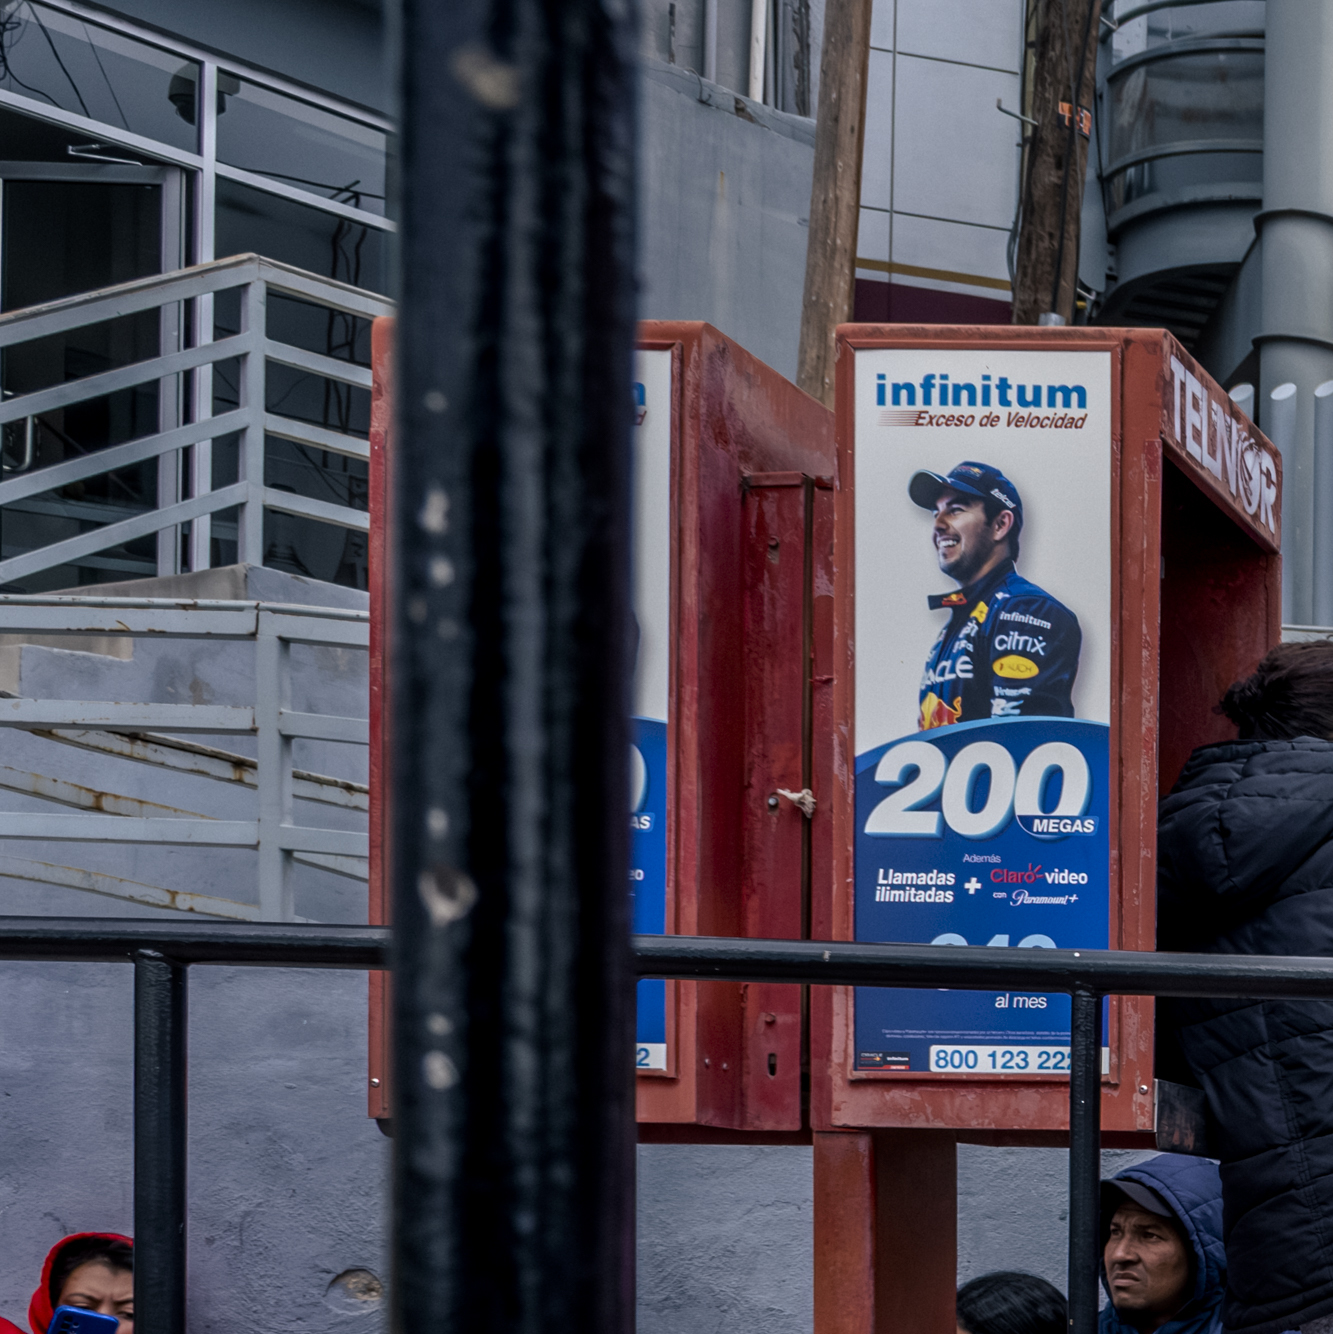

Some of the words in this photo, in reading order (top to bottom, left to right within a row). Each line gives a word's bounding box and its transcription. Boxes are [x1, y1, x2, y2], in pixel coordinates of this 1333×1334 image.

[876, 373, 1087, 409] infinitum
[914, 410, 975, 427] Exceso
[979, 411, 1000, 427] de
[1006, 411, 1088, 429] Velocidad
[1170, 354, 1277, 534] TELNOR
[1000, 611, 1051, 629] infinitum
[994, 631, 1046, 655] citrix
[864, 740, 1091, 840] 200
[1033, 819, 1094, 833] MEGAS
[963, 853, 1001, 863] Además
[877, 868, 955, 885] Llamadas
[1045, 868, 1088, 884] video
[875, 886, 954, 903] ilimitadas
[994, 993, 1009, 1008] al
[1013, 996, 1047, 1009] mes
[935, 1049, 978, 1069] 800
[987, 1050, 1029, 1070] 123
[1037, 1050, 1071, 1070] 22
